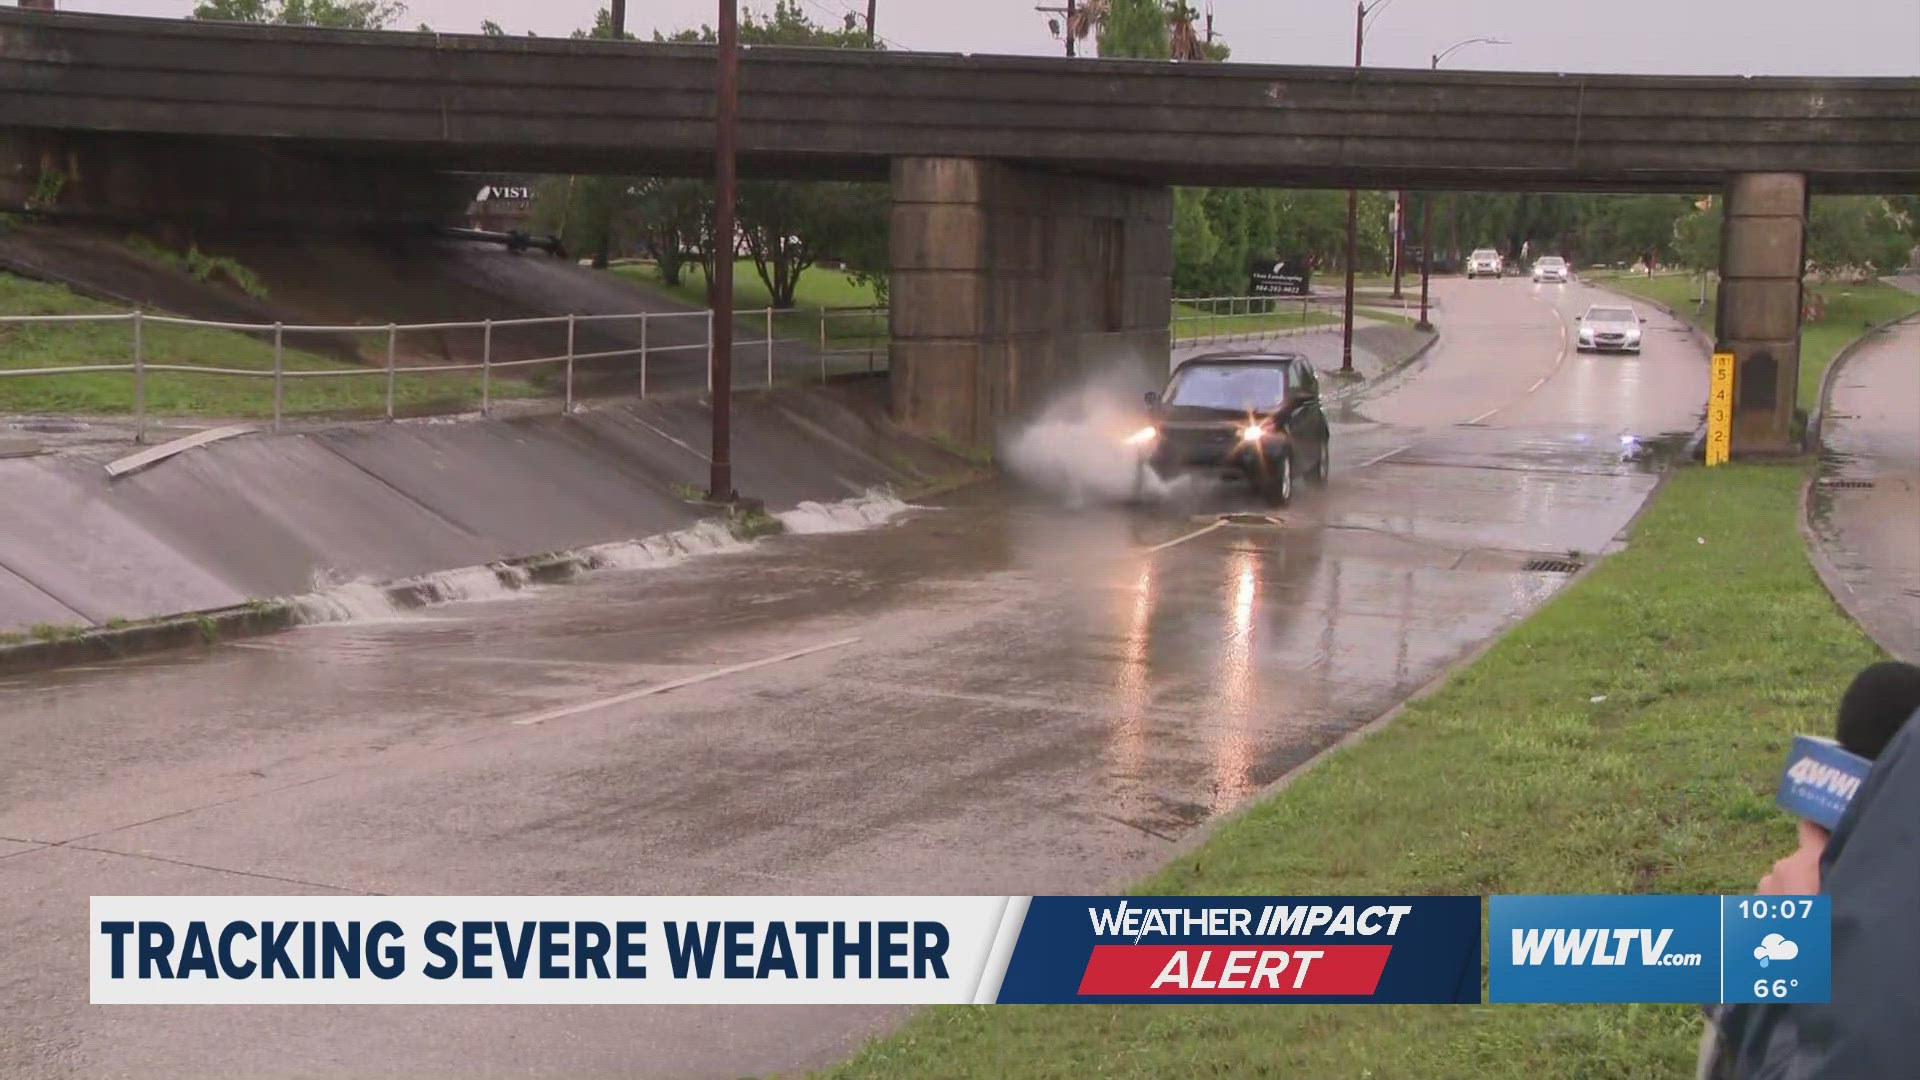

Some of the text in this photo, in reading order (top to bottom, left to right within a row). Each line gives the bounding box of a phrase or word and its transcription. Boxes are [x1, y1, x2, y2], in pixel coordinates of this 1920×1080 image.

[491, 186, 534, 199] VIST
[1718, 369, 1727, 380] 5
[1716, 389, 1725, 400] 4
[1715, 410, 1724, 421] 3
[1714, 431, 1723, 442] 2
